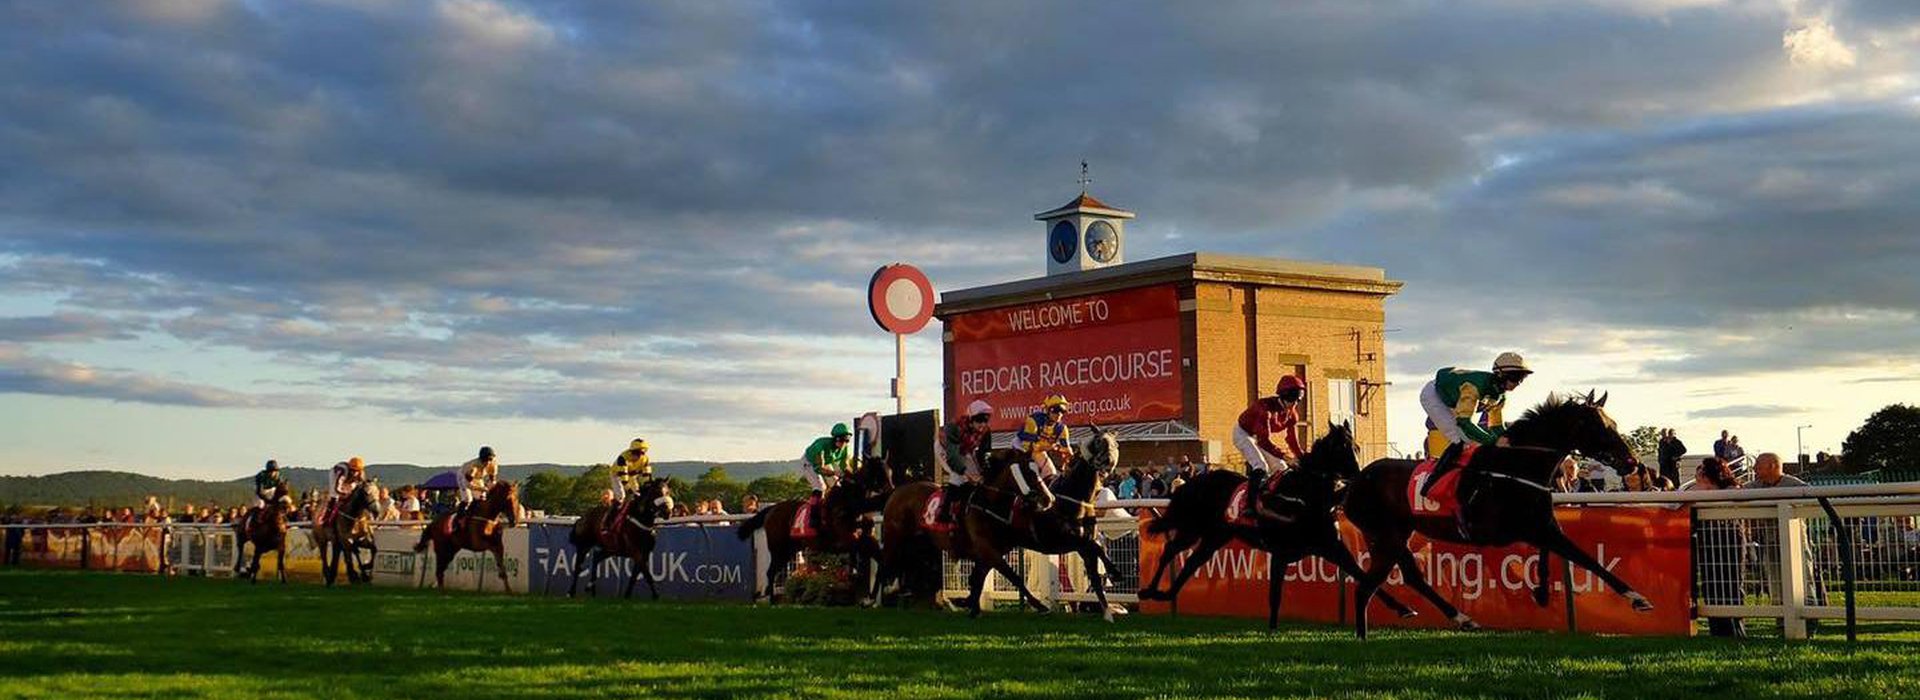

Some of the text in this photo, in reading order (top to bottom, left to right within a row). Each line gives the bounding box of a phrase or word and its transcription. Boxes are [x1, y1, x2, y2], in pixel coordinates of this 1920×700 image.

[1008, 299, 1110, 332] WELCOME TO
[961, 349, 1174, 396] REDCAR RACECOURSE
[1000, 394, 1132, 419] www.reacing.co.uk
